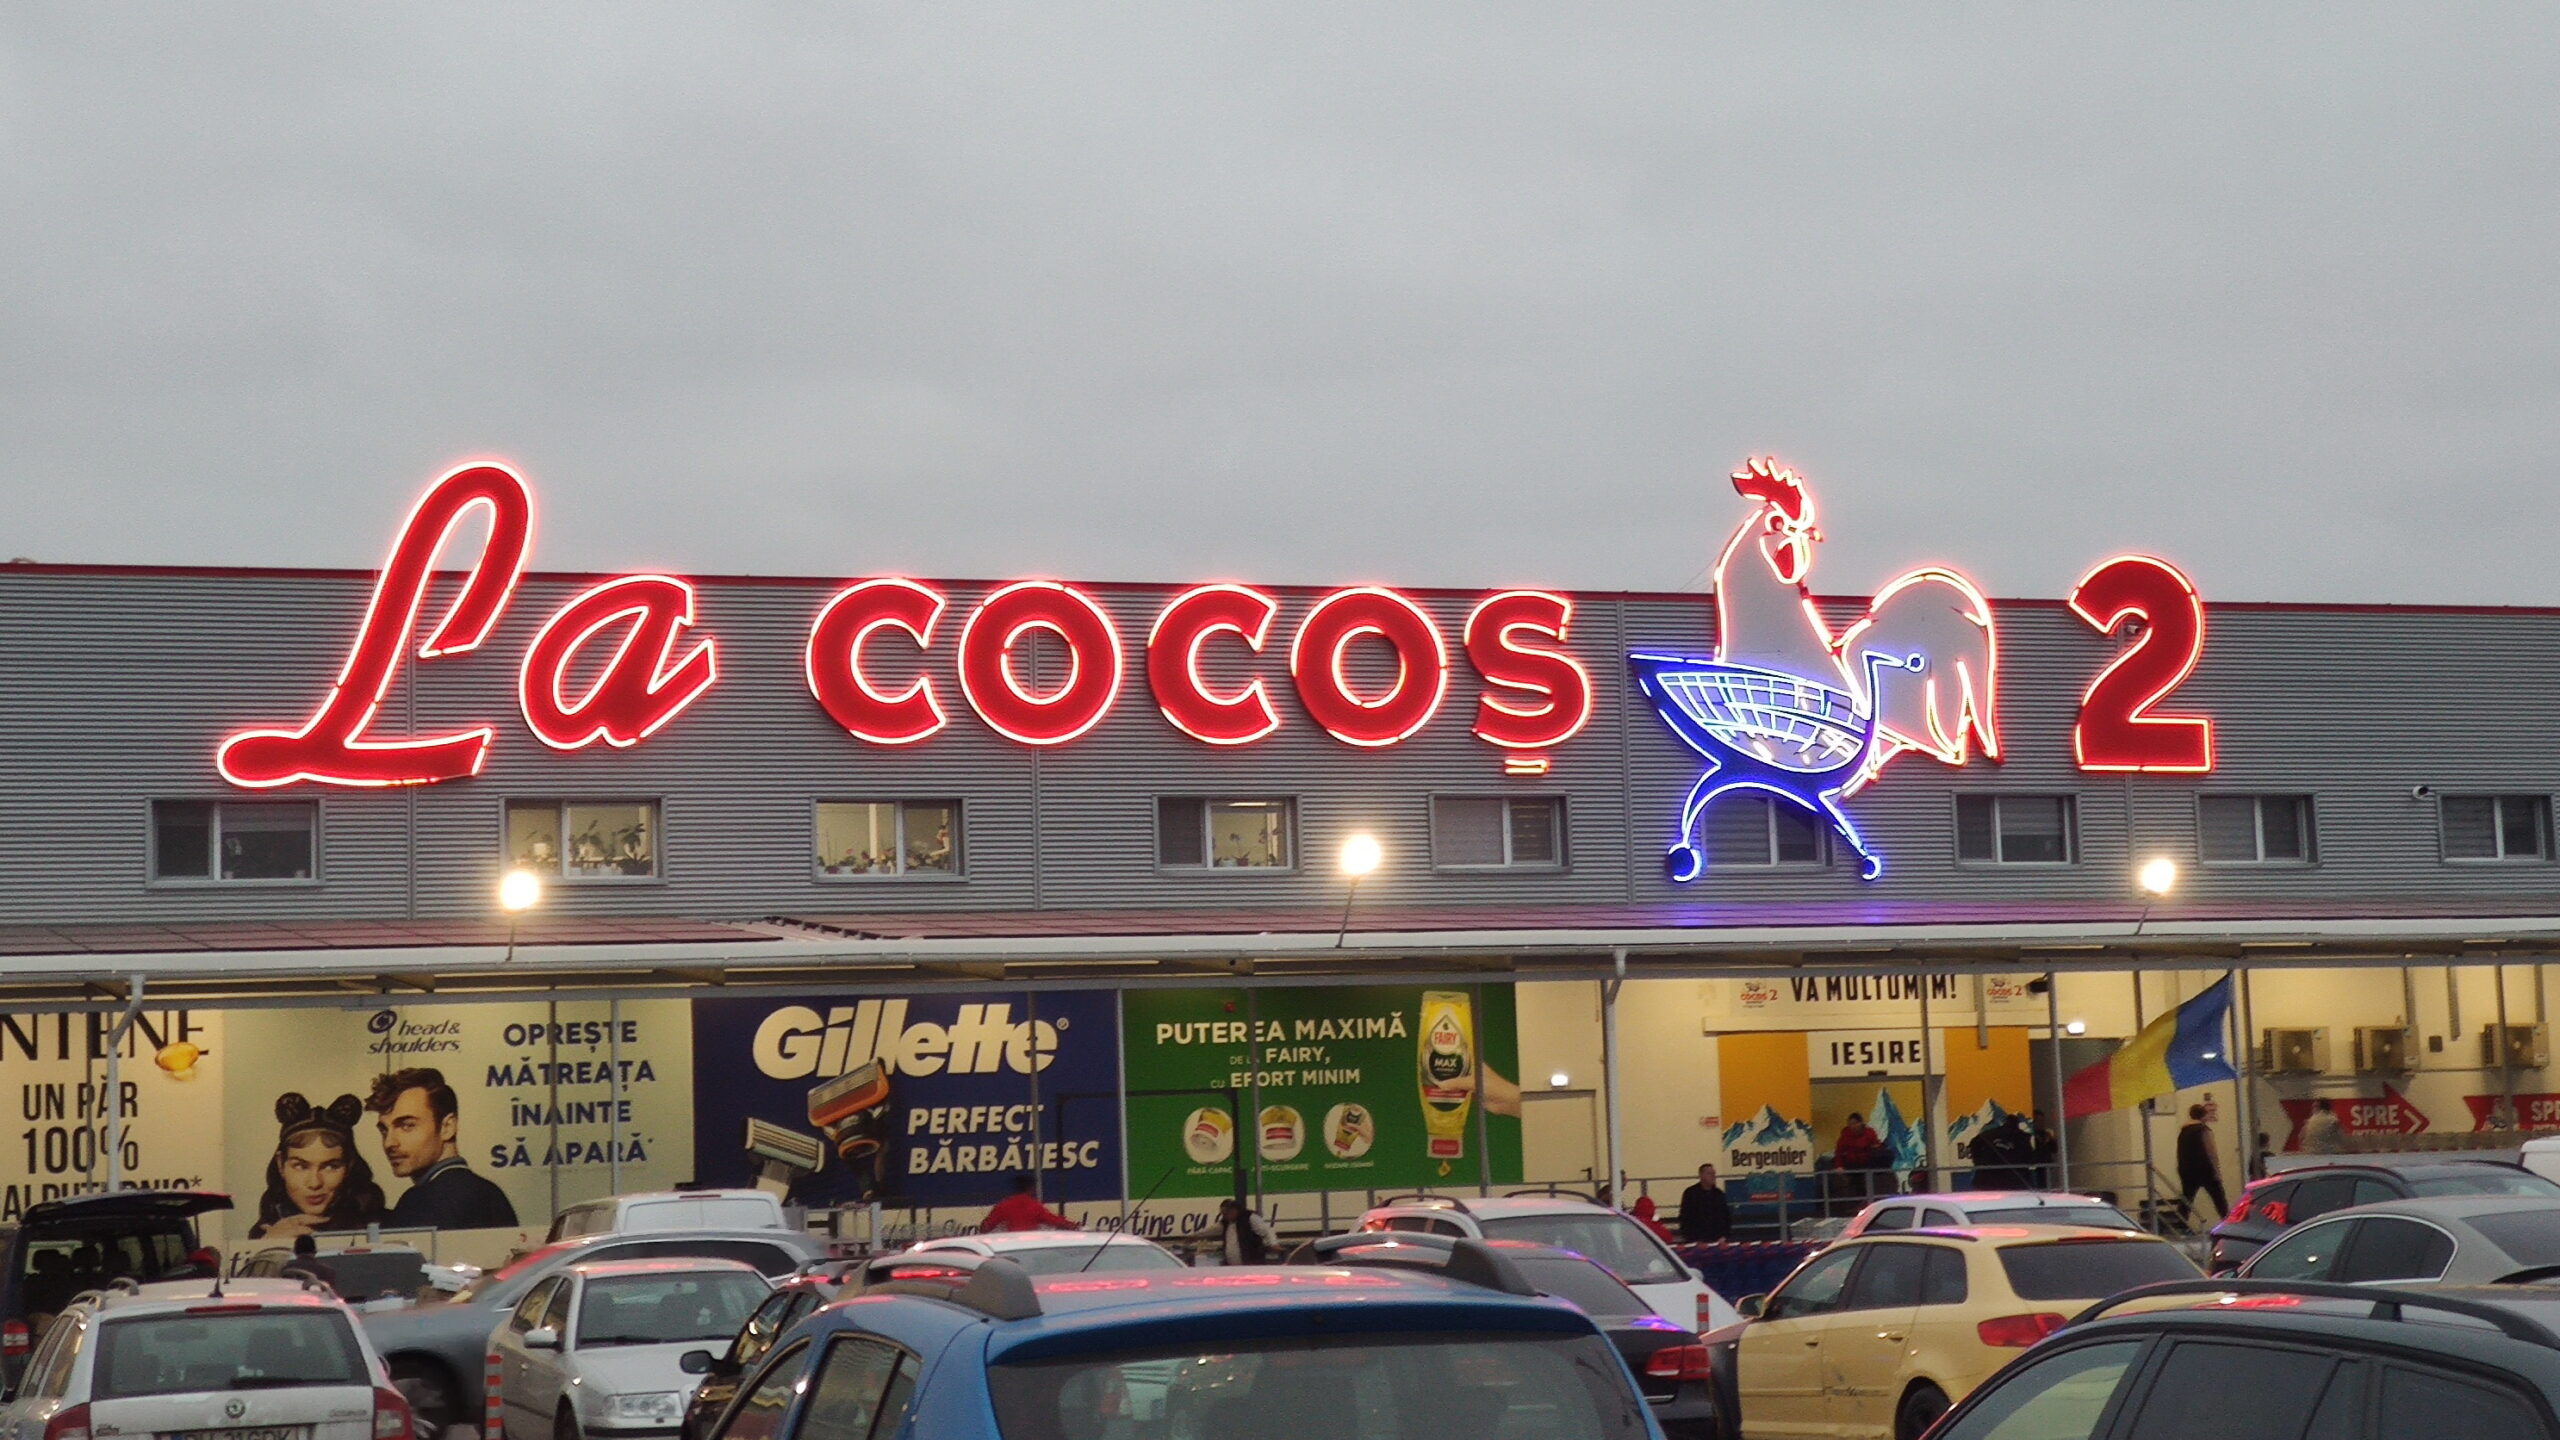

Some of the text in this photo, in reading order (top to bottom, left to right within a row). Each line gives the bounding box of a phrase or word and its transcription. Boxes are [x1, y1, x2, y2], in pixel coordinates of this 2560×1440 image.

[215, 460, 718, 789] La
[2068, 554, 2212, 774] 2
[1826, 974, 1957, 1002] MULTUMM!
[503, 1020, 638, 1053] OPREȘTE
[752, 999, 1058, 1080] Gillette
[1156, 1012, 1407, 1045] PUTEREA MAXIMĂ
[1434, 1031, 1457, 1046] FAIRY
[1229, 1055, 1244, 1065] DE
[1265, 1046, 1331, 1065] FAIRY,
[1434, 1057, 1457, 1069] MAX
[1831, 1039, 1921, 1066] IESIRE
[485, 1056, 656, 1092] MĂTREAȚA
[1230, 1070, 1296, 1088] EFORT
[1302, 1068, 1361, 1086] MINIM
[22, 1083, 65, 1121] UN
[511, 1097, 632, 1126] ÎNAINTE
[2350, 1103, 2401, 1127] SPRE
[908, 1104, 1044, 1135] PERFECT
[490, 1136, 532, 1168] SĂ
[908, 1136, 1100, 1174] BĂRBĂTESC
[1731, 1147, 1807, 1170] Bergenbier
